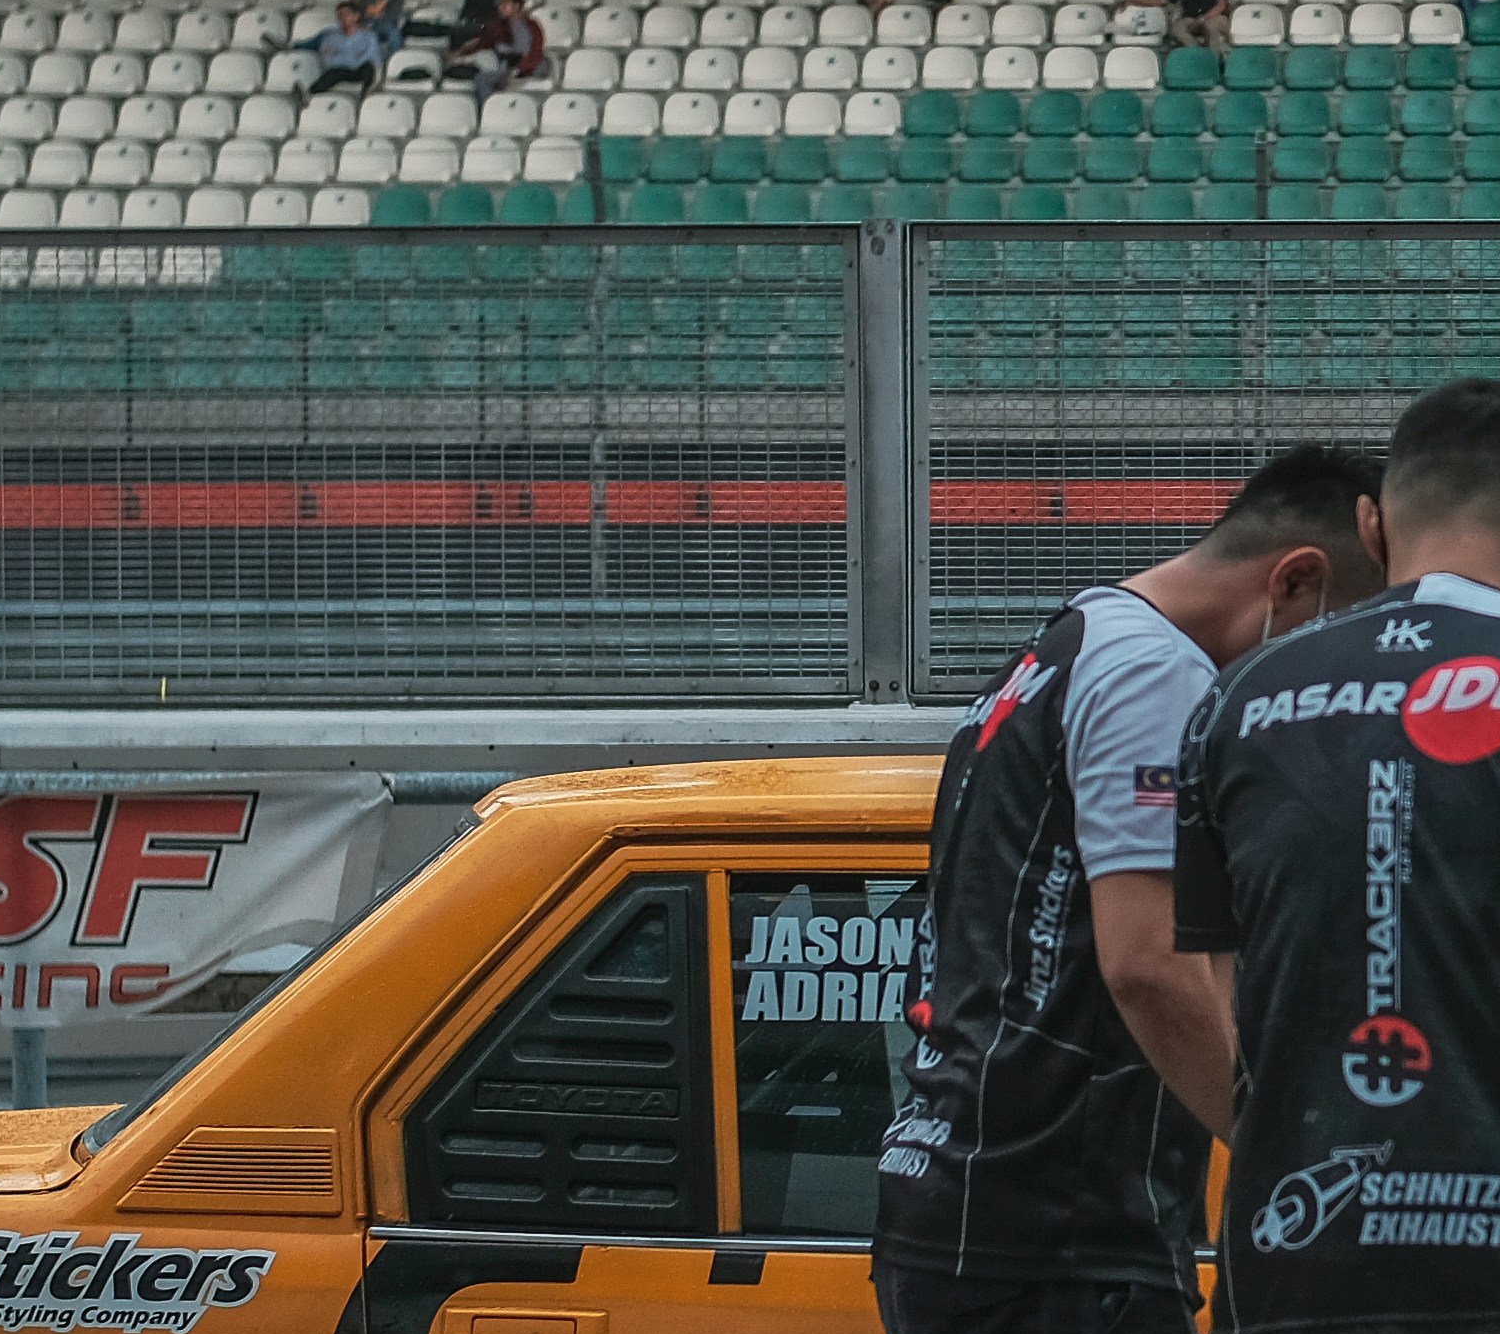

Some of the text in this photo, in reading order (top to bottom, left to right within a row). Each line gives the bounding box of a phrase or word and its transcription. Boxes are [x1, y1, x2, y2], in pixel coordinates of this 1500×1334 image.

[1237, 680, 1409, 739] PASAR
[745, 916, 915, 965] JASON
[80, 1305, 198, 1331] Company
